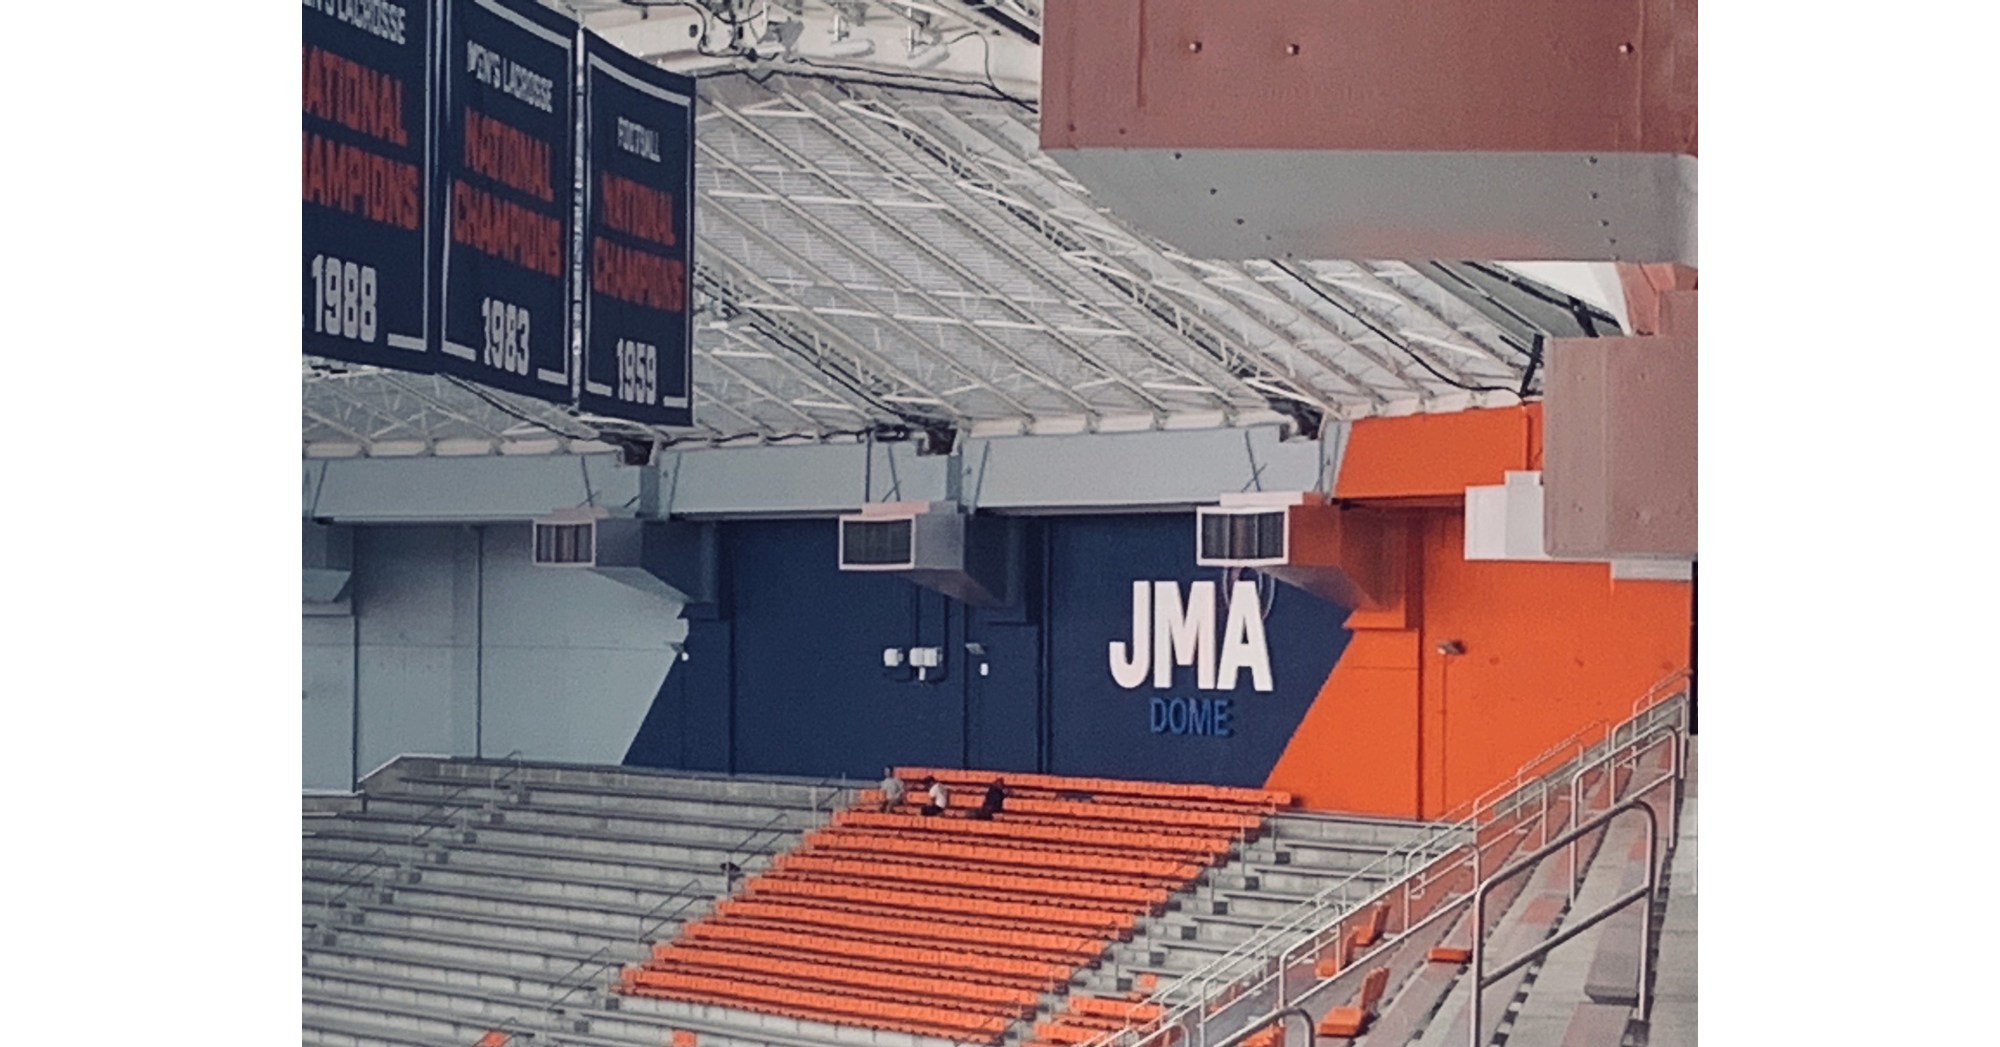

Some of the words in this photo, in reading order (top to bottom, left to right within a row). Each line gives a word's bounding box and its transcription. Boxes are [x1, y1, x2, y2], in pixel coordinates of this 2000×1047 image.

[465, 106, 554, 202] NATIONAL
[454, 178, 561, 277] CHAMPIONS
[602, 171, 676, 246] NATIONAL
[312, 254, 377, 343] 1988
[594, 236, 685, 312] CHAMPIONS
[482, 297, 530, 376] 1983
[617, 338, 657, 405] 1959
[1109, 580, 1273, 691] JMA
[1151, 698, 1231, 737] DOME
